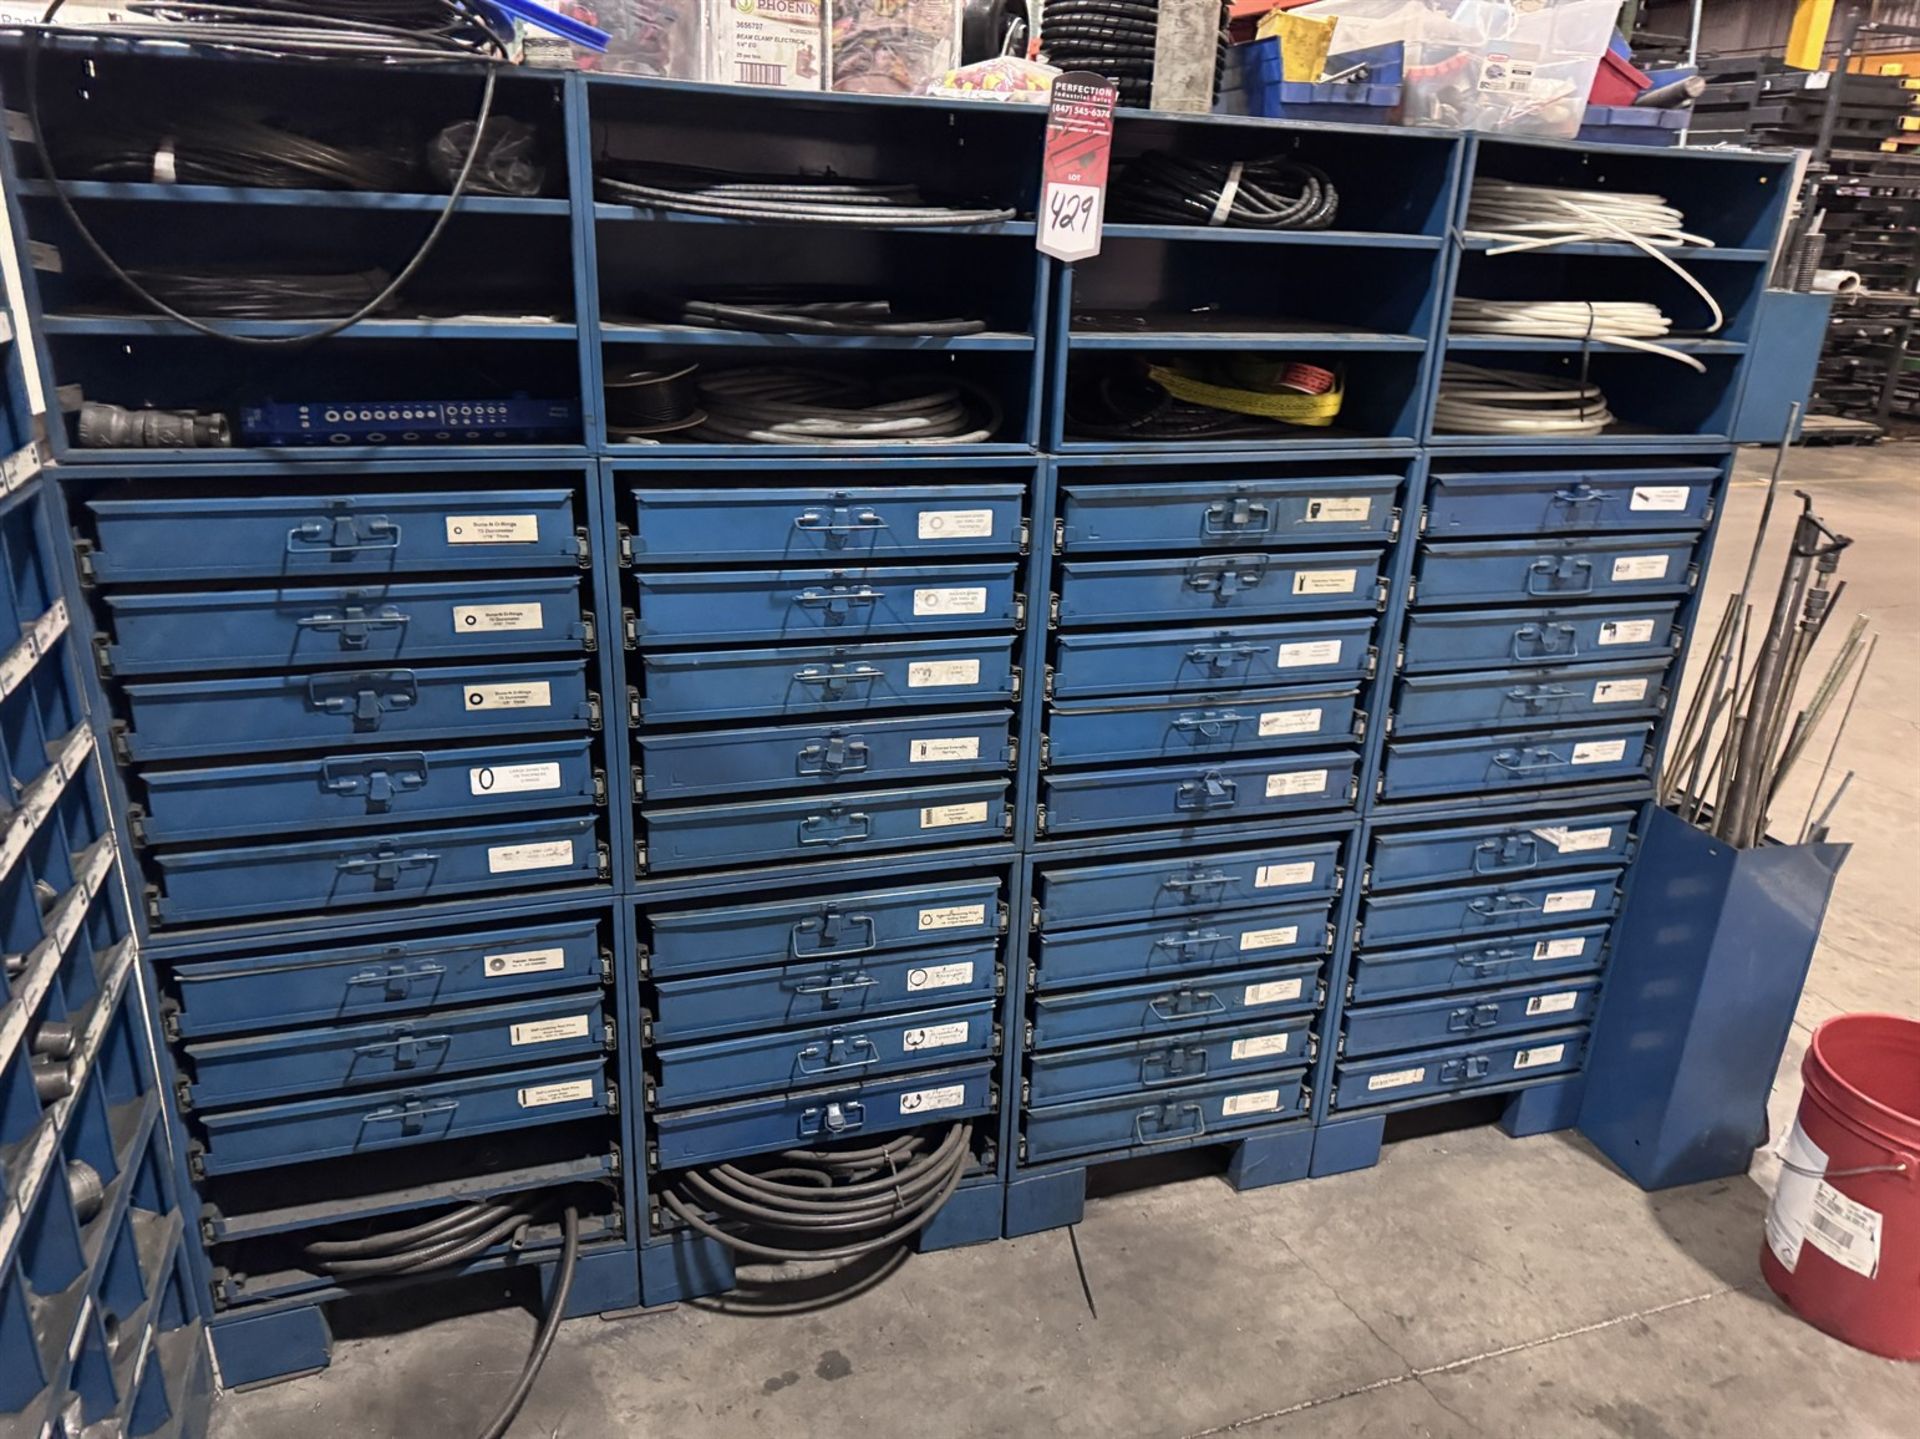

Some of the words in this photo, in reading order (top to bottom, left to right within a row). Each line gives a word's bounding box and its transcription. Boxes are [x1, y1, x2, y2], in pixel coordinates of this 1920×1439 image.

[757, 0, 818, 16] PHOENIX
[754, 34, 773, 42] CLAMP
[1055, 82, 1113, 97] PERFECTION
[1054, 91, 1090, 101] Industrial
[1092, 95, 1112, 104] Sales
[1052, 104, 1073, 116] (847)
[1068, 173, 1081, 181] LOT
[1051, 190, 1094, 233] 429
